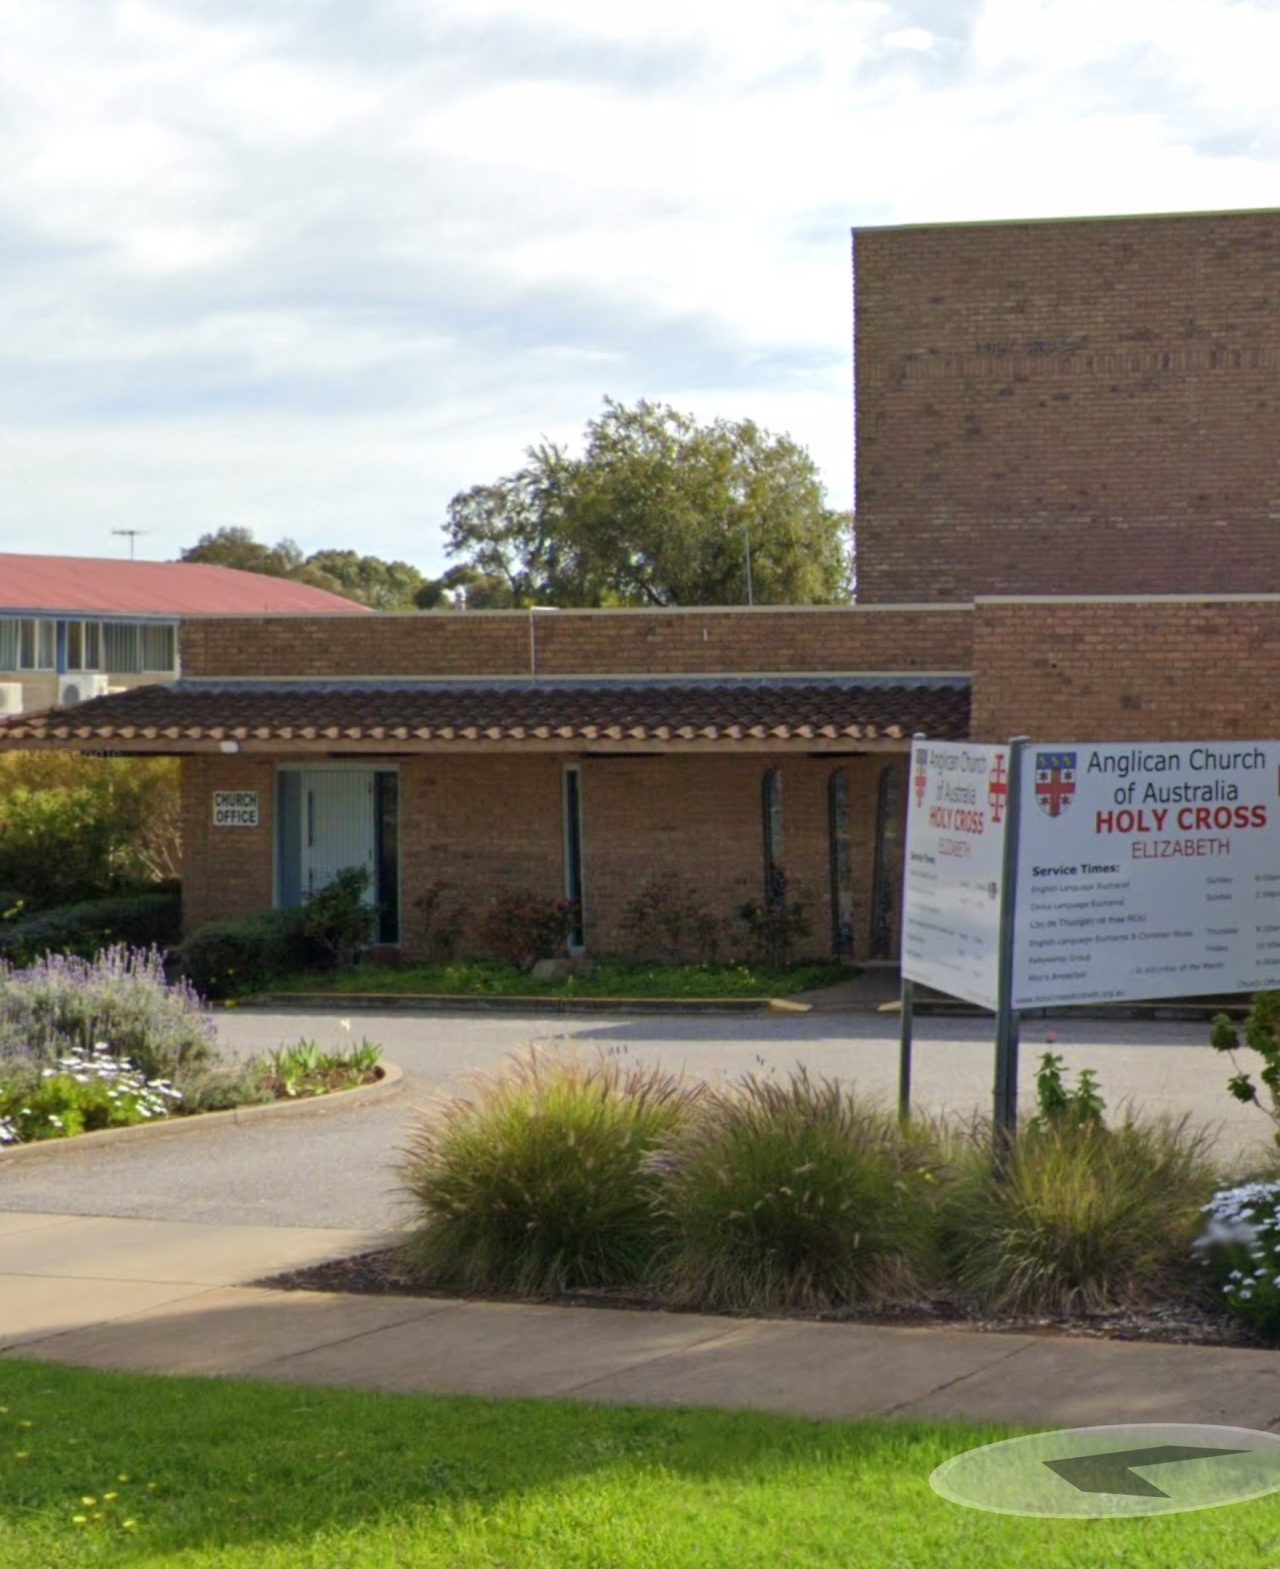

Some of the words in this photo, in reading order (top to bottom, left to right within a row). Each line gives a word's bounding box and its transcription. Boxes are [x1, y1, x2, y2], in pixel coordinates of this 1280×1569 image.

[930, 749, 960, 776] Anglican
[961, 751, 986, 774] Church
[1087, 750, 1181, 777] Anglican
[1189, 748, 1266, 771] Church
[216, 793, 256, 808] CHURCH
[945, 781, 977, 806] Australia
[1114, 783, 1136, 806] of
[1142, 780, 1239, 805] Australia
[216, 810, 257, 823] OFFICE
[929, 805, 953, 830] HOLY
[954, 809, 984, 835] CROSS
[1095, 808, 1168, 835] HOLY
[1177, 805, 1268, 831] CROSS
[1131, 839, 1230, 860] ELIZABETH
[1032, 865, 1077, 878] Service
[1081, 863, 1120, 875] Times:
